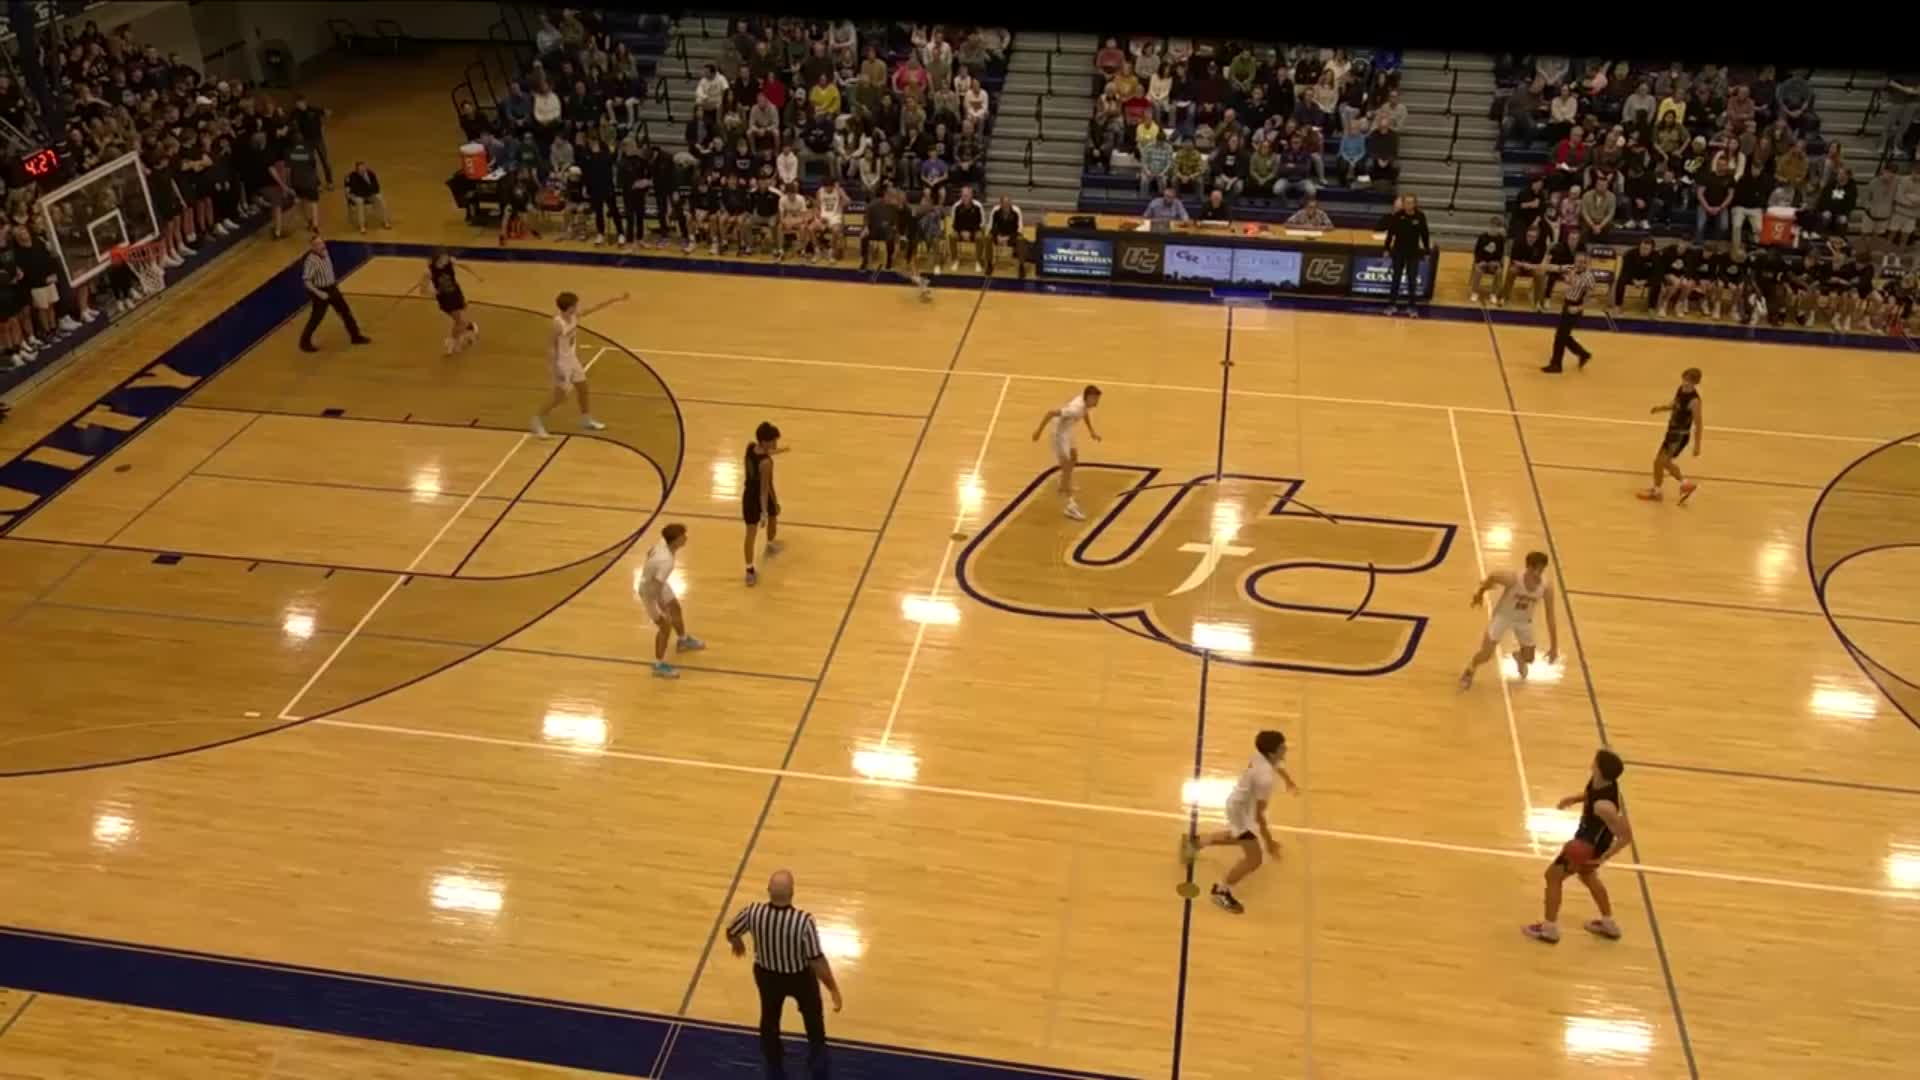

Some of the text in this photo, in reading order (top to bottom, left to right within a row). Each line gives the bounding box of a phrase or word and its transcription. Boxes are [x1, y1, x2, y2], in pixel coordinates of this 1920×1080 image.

[24, 149, 58, 176] 4:27
[1122, 246, 1160, 274] UC
[1306, 257, 1345, 285] UC
[955, 462, 1458, 677] UC
